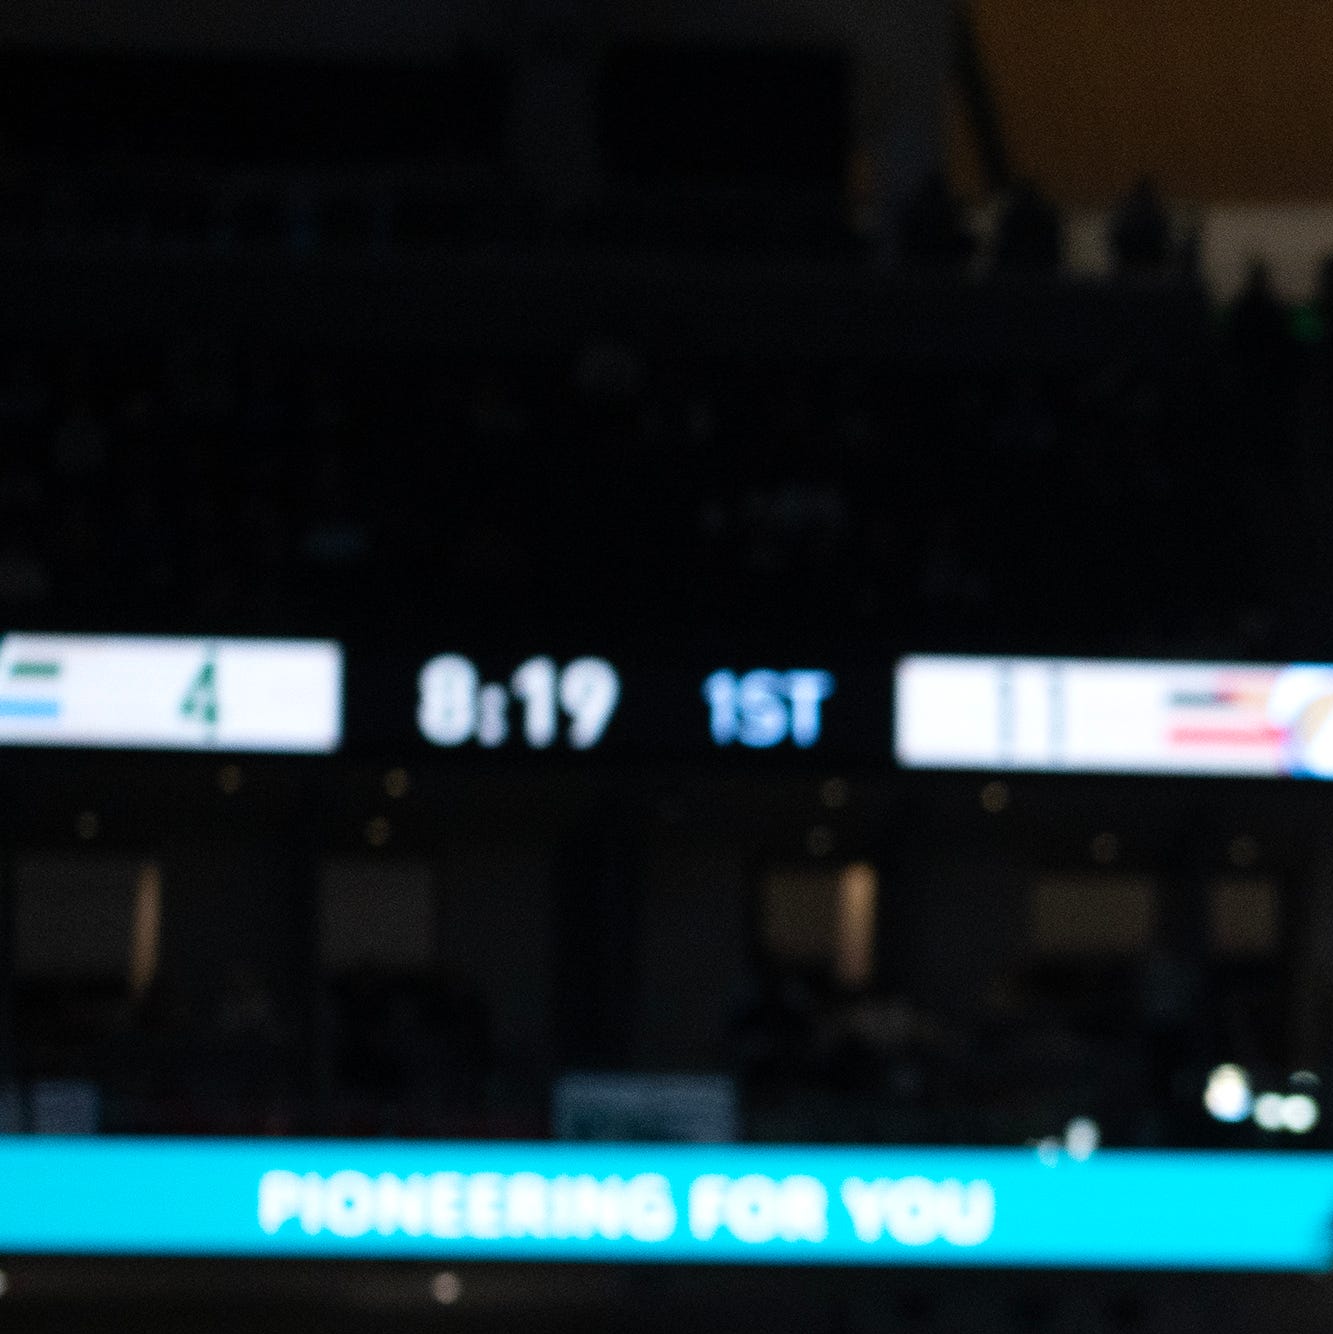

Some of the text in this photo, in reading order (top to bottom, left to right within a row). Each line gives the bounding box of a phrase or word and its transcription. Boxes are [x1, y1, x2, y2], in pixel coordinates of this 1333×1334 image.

[177, 657, 220, 727] 4
[417, 653, 836, 749] 8:19 1ST
[256, 1169, 997, 1247] PIONEERING FOR YOU
